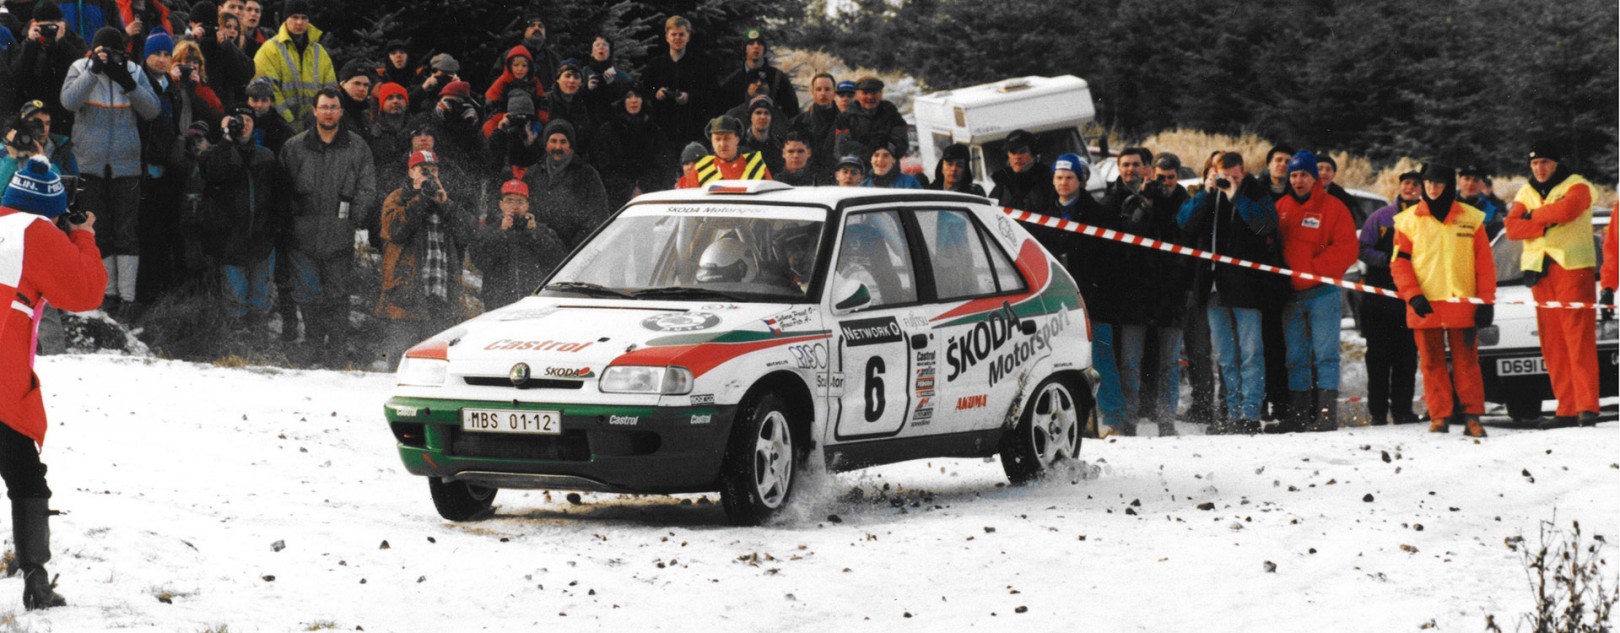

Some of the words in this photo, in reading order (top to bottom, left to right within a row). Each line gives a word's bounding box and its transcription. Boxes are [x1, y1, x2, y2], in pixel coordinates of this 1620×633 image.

[889, 321, 900, 336] Q
[483, 338, 593, 353] Castrol
[946, 300, 1022, 383] ŠKODA
[989, 302, 1071, 388] Motorsport
[916, 350, 936, 361] Castrol
[544, 365, 580, 378] ŠKODA
[1501, 359, 1538, 374] D691
[864, 355, 886, 423] 6
[955, 394, 988, 410] AKUMA
[471, 412, 499, 429] MBS
[509, 413, 551, 430] 01-12
[609, 415, 639, 425] Castrol
[690, 414, 712, 425] Castrol
